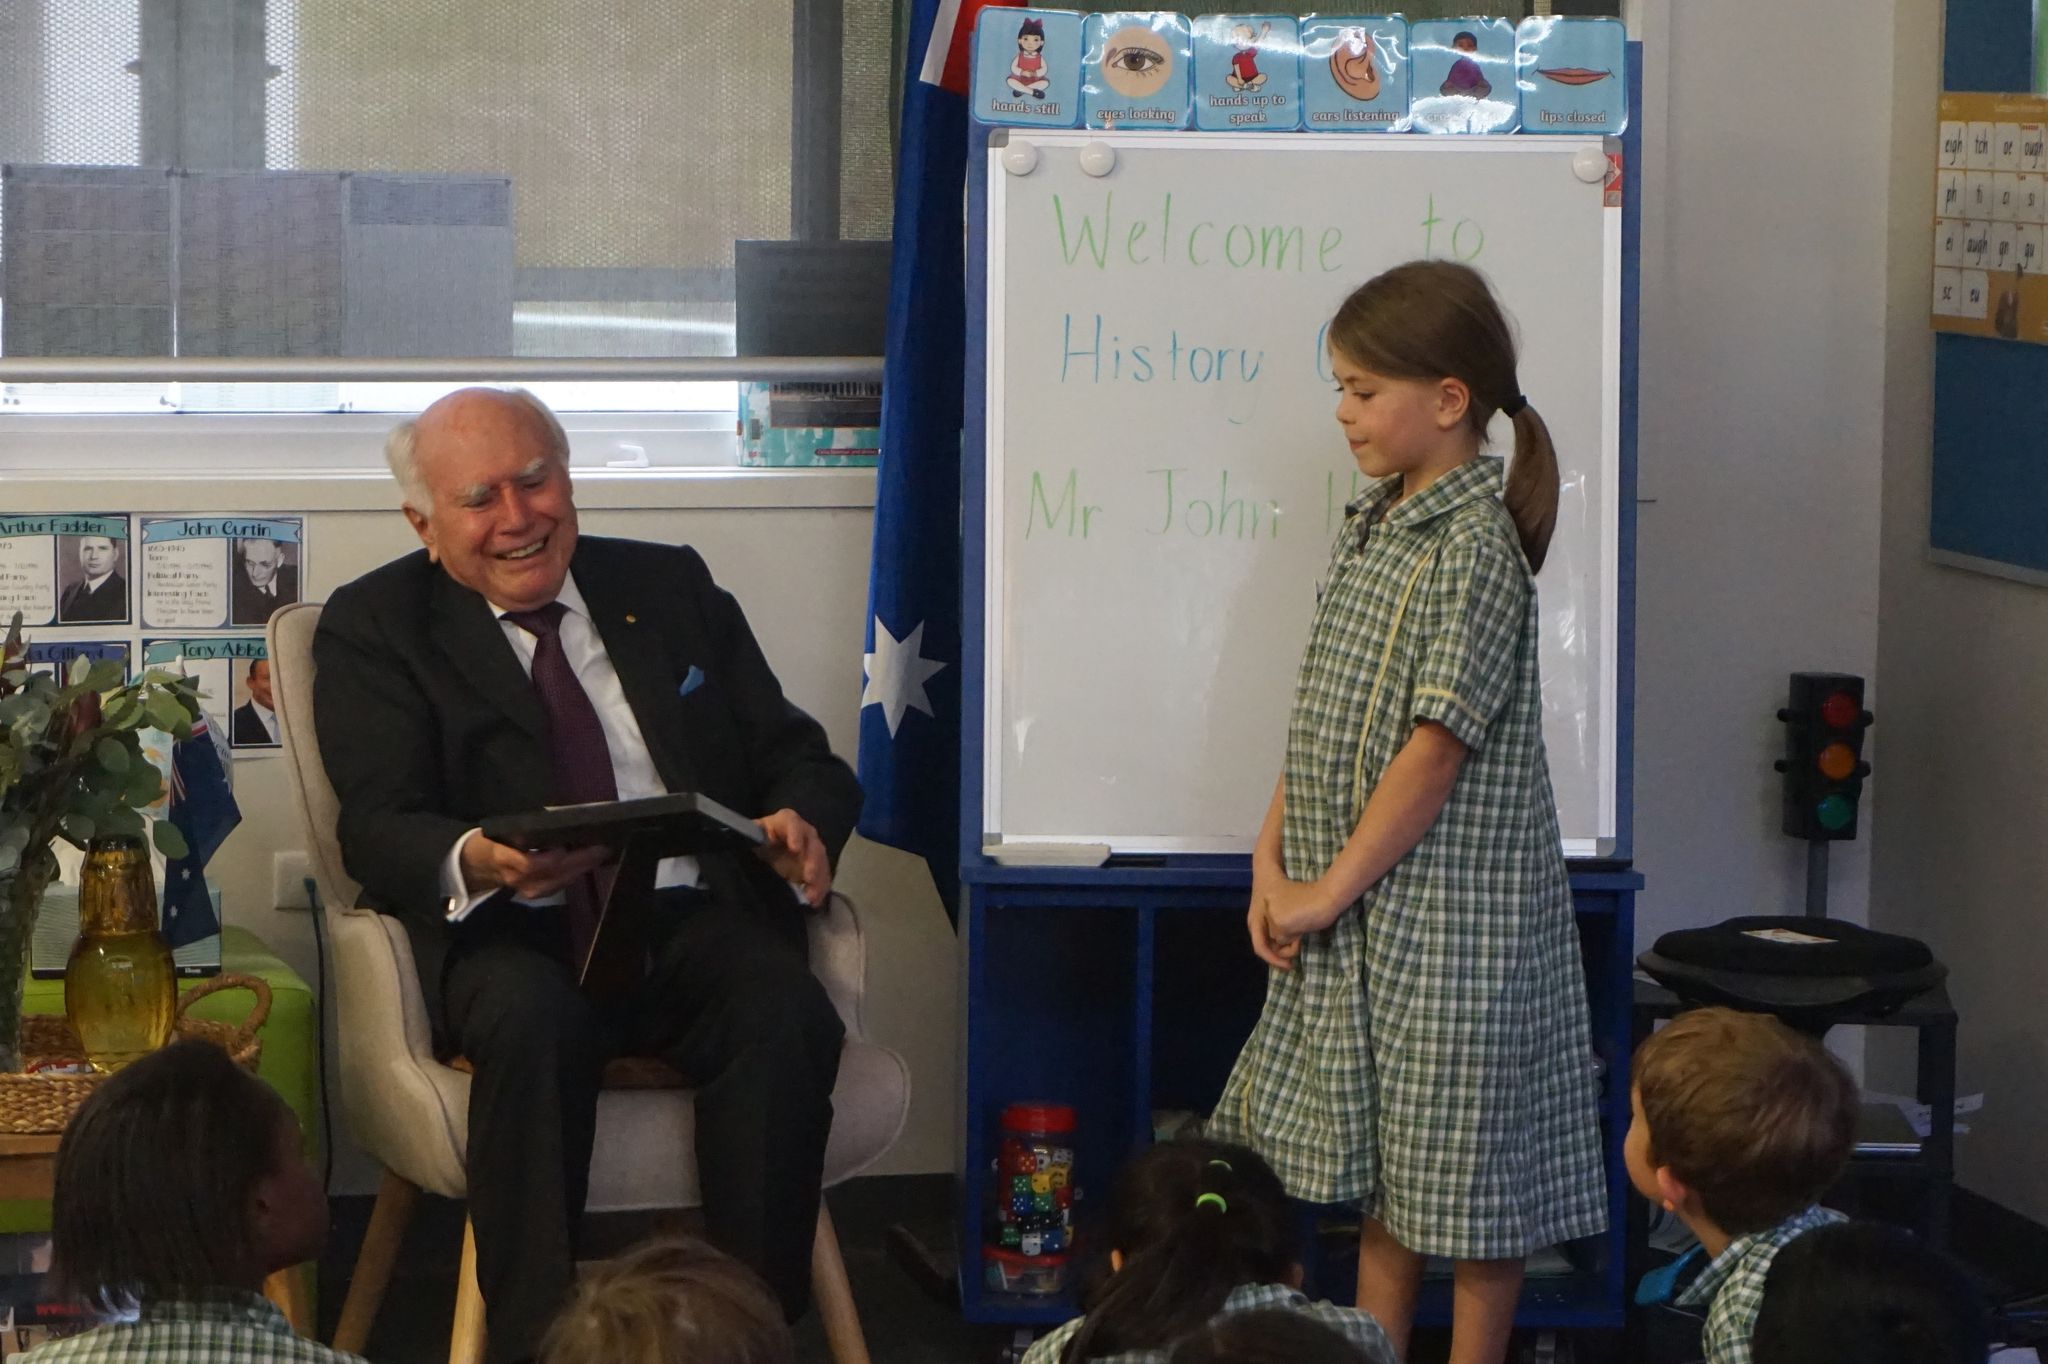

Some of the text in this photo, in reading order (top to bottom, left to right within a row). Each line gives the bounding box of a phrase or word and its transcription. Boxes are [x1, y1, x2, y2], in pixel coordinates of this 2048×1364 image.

[991, 99, 1061, 116] hands still
[1209, 95, 1287, 109] hands up to
[1096, 106, 1176, 123] eyes looking
[1229, 110, 1268, 125] speak
[1312, 109, 1401, 124] ears listening
[1540, 109, 1607, 123] lips closed
[1051, 189, 1485, 273] Welcome to
[1060, 312, 1266, 424] History
[1024, 467, 1104, 540] Mr
[1144, 467, 1285, 540] John
[49, 518, 107, 533] Fadden
[177, 520, 272, 537] John Curtin
[180, 641, 267, 660] Tony Abbo
